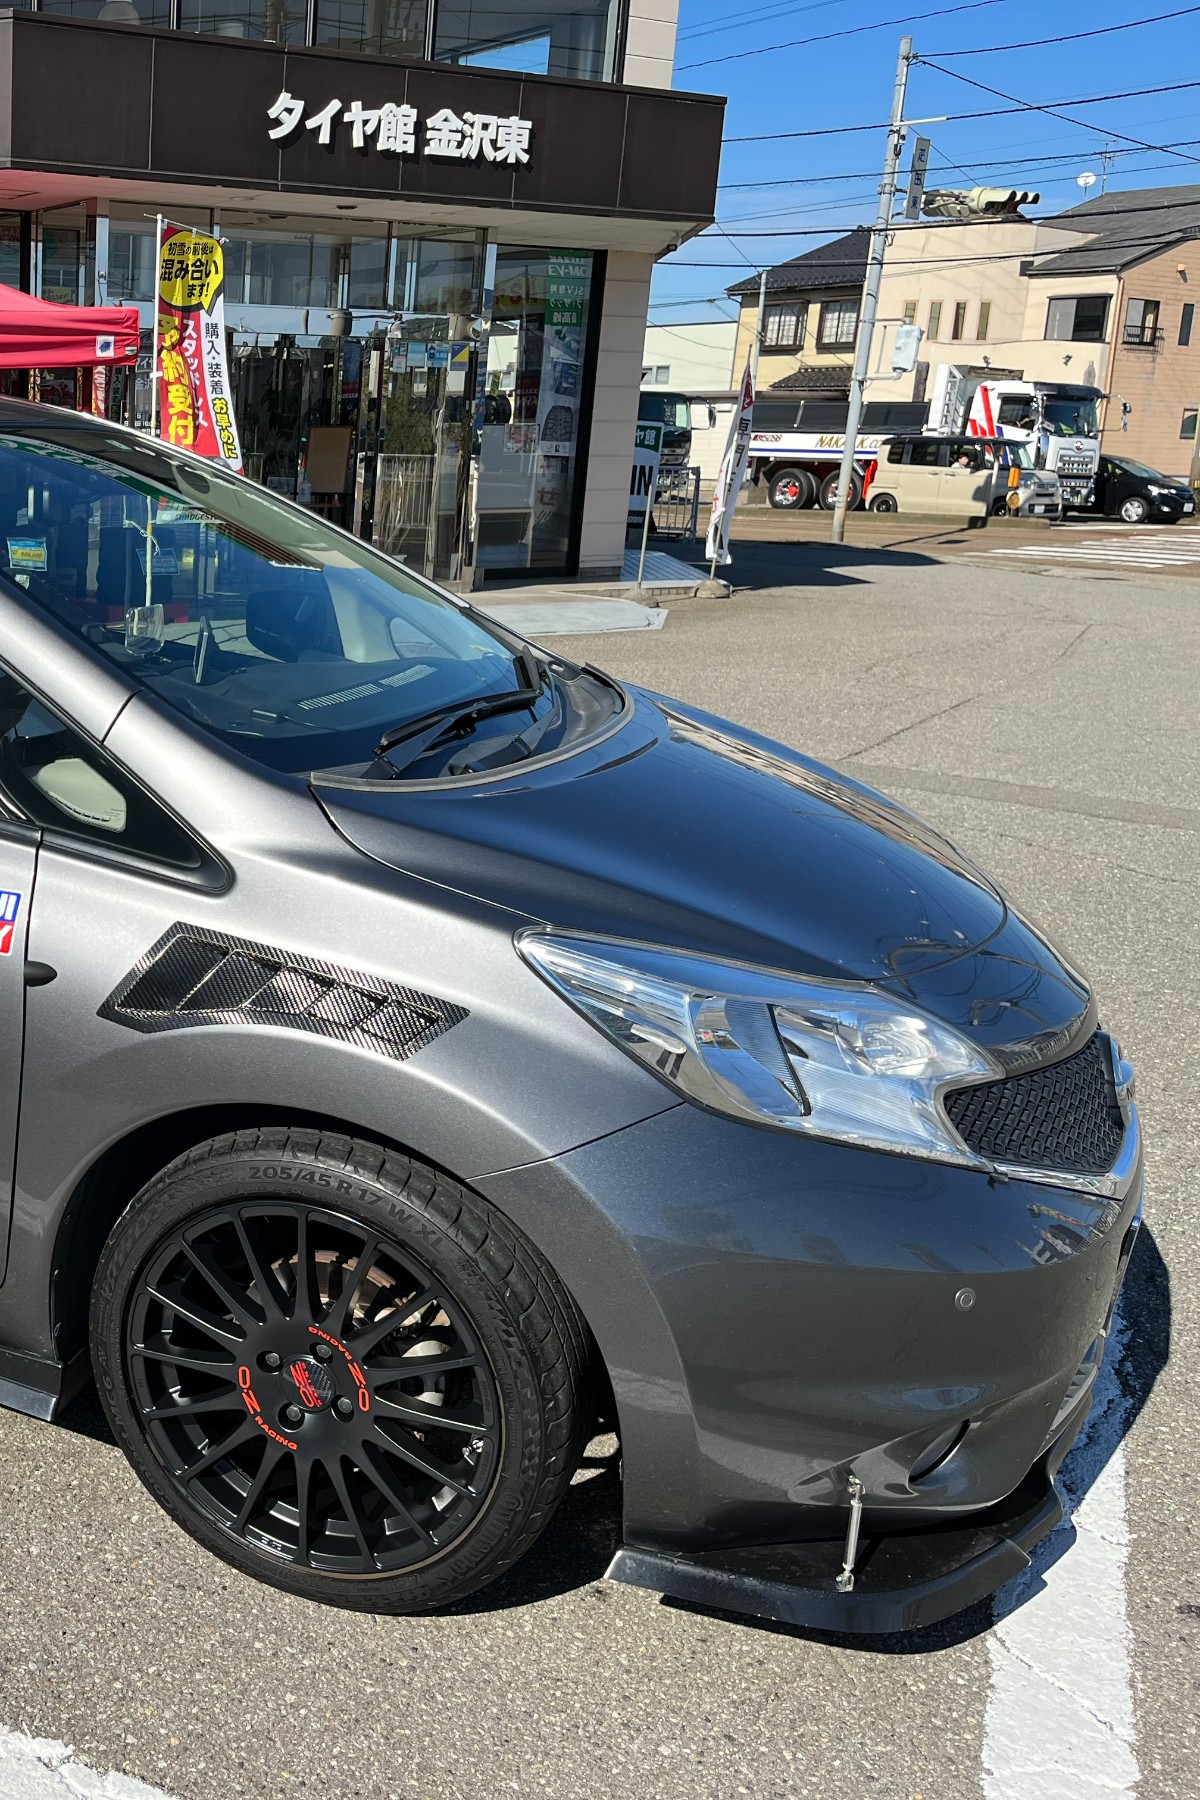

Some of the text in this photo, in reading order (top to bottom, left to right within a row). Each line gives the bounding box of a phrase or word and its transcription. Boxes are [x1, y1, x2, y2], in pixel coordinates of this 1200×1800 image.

[266, 91, 533, 164] タイヤ館 金沢東
[168, 242, 214, 256] 初雪の前後は
[160, 258, 219, 281] 混み合い
[158, 314, 194, 445] 予約受付
[182, 319, 209, 428] スタッドレス
[248, 1166, 332, 1188] 205/45
[307, 1326, 353, 1360] RACING
[254, 1415, 298, 1450] RACING
